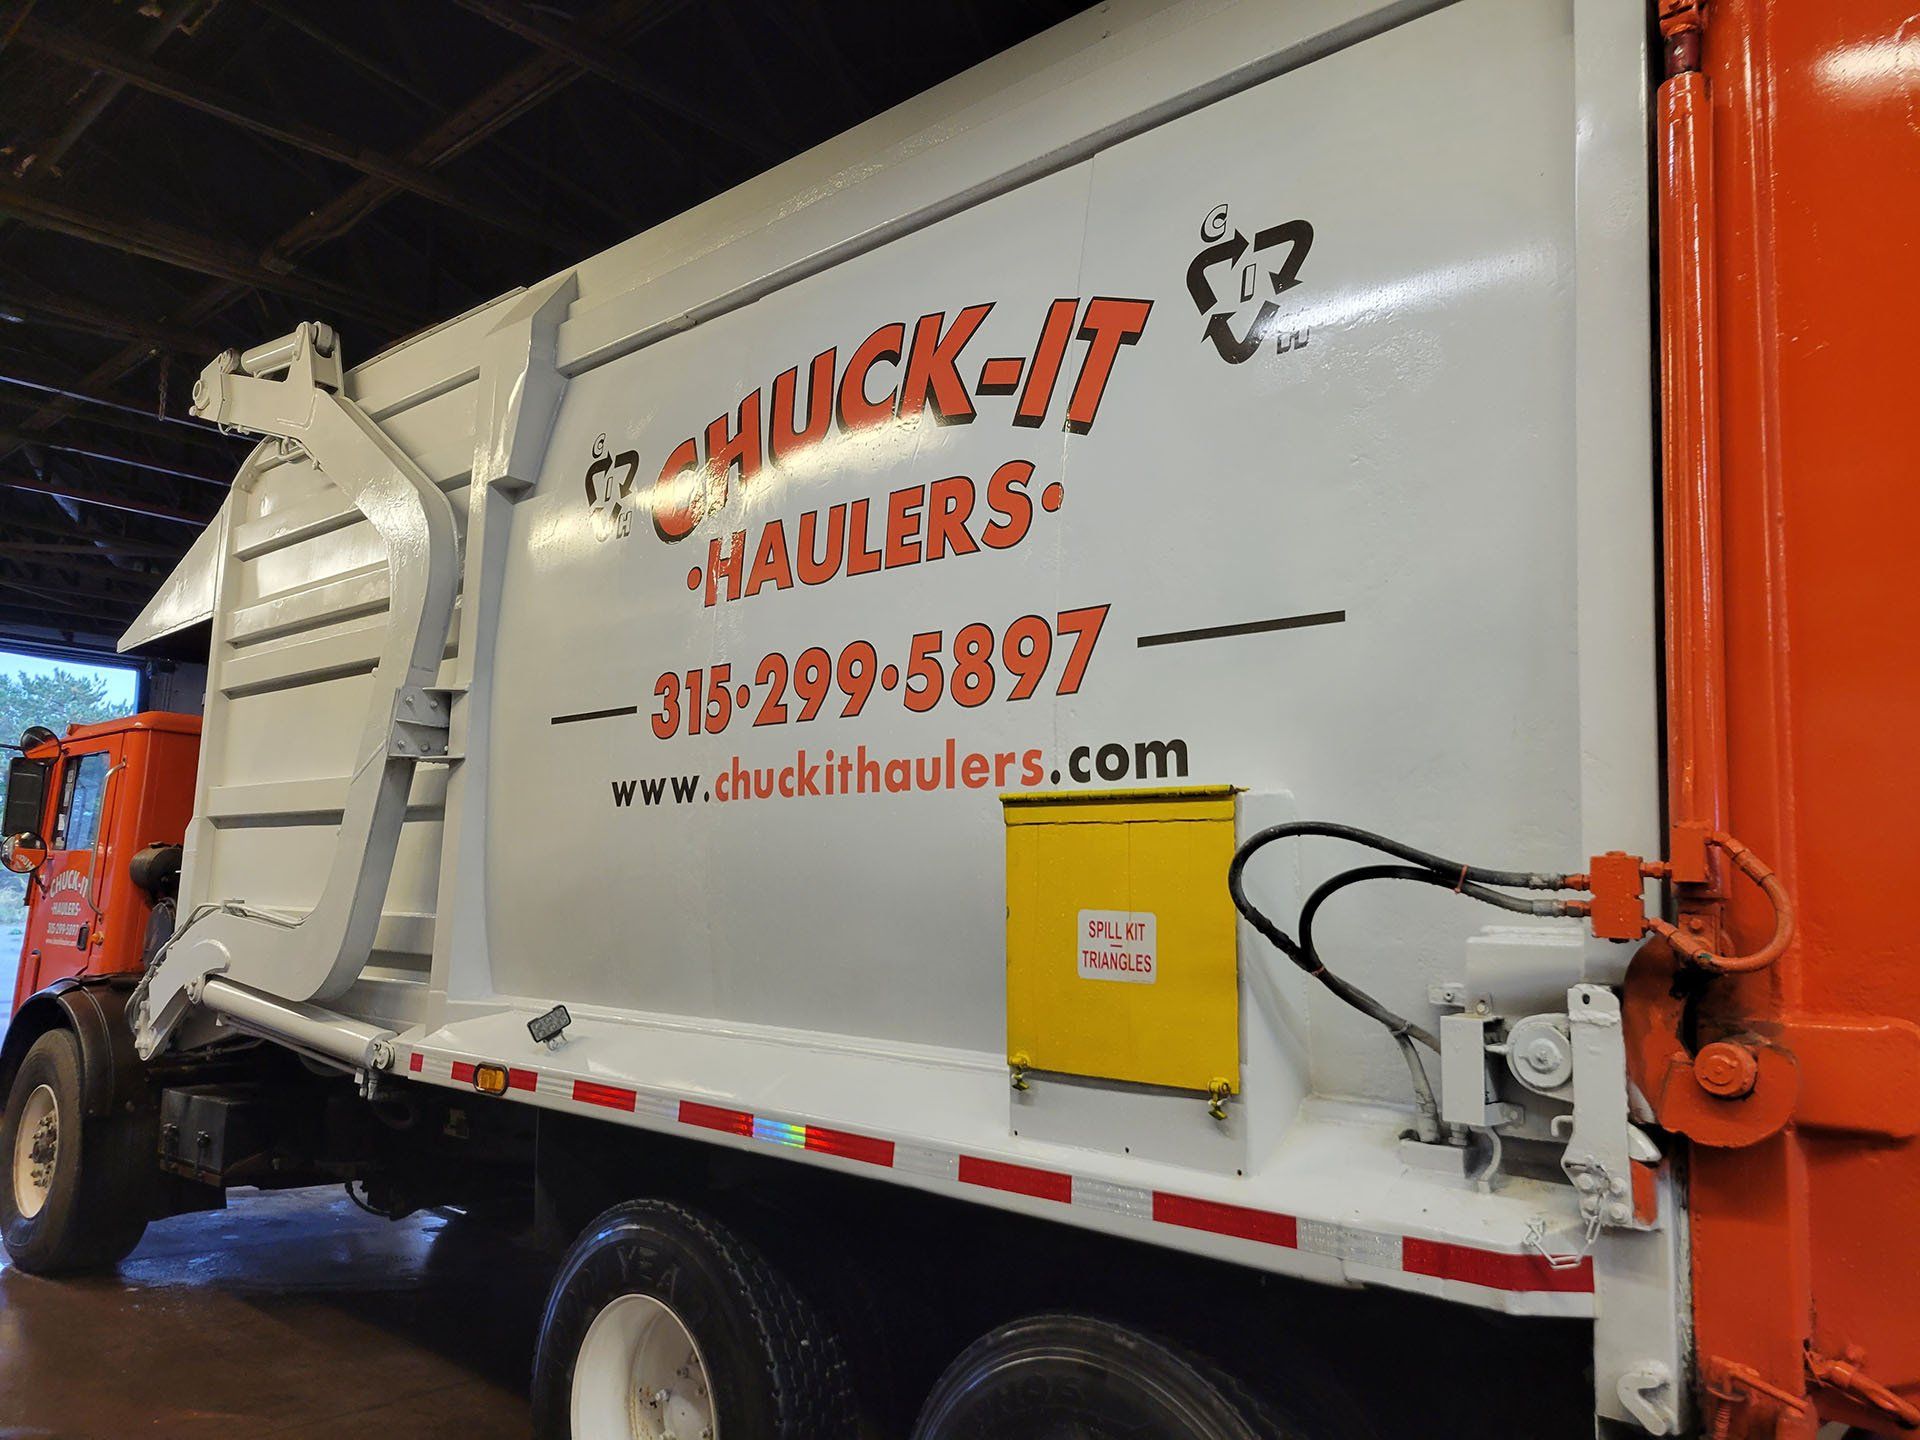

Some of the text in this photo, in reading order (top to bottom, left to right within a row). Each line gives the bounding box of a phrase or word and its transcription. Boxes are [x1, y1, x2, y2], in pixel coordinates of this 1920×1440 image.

[1200, 203, 1229, 244] C
[651, 296, 1155, 545] CHUCK-IT
[591, 432, 607, 459] C
[611, 738, 1190, 808] www.chuckithaulers.com
[1088, 920, 1146, 941] SPILL KIT
[1082, 950, 1152, 973] TRIANGLES
